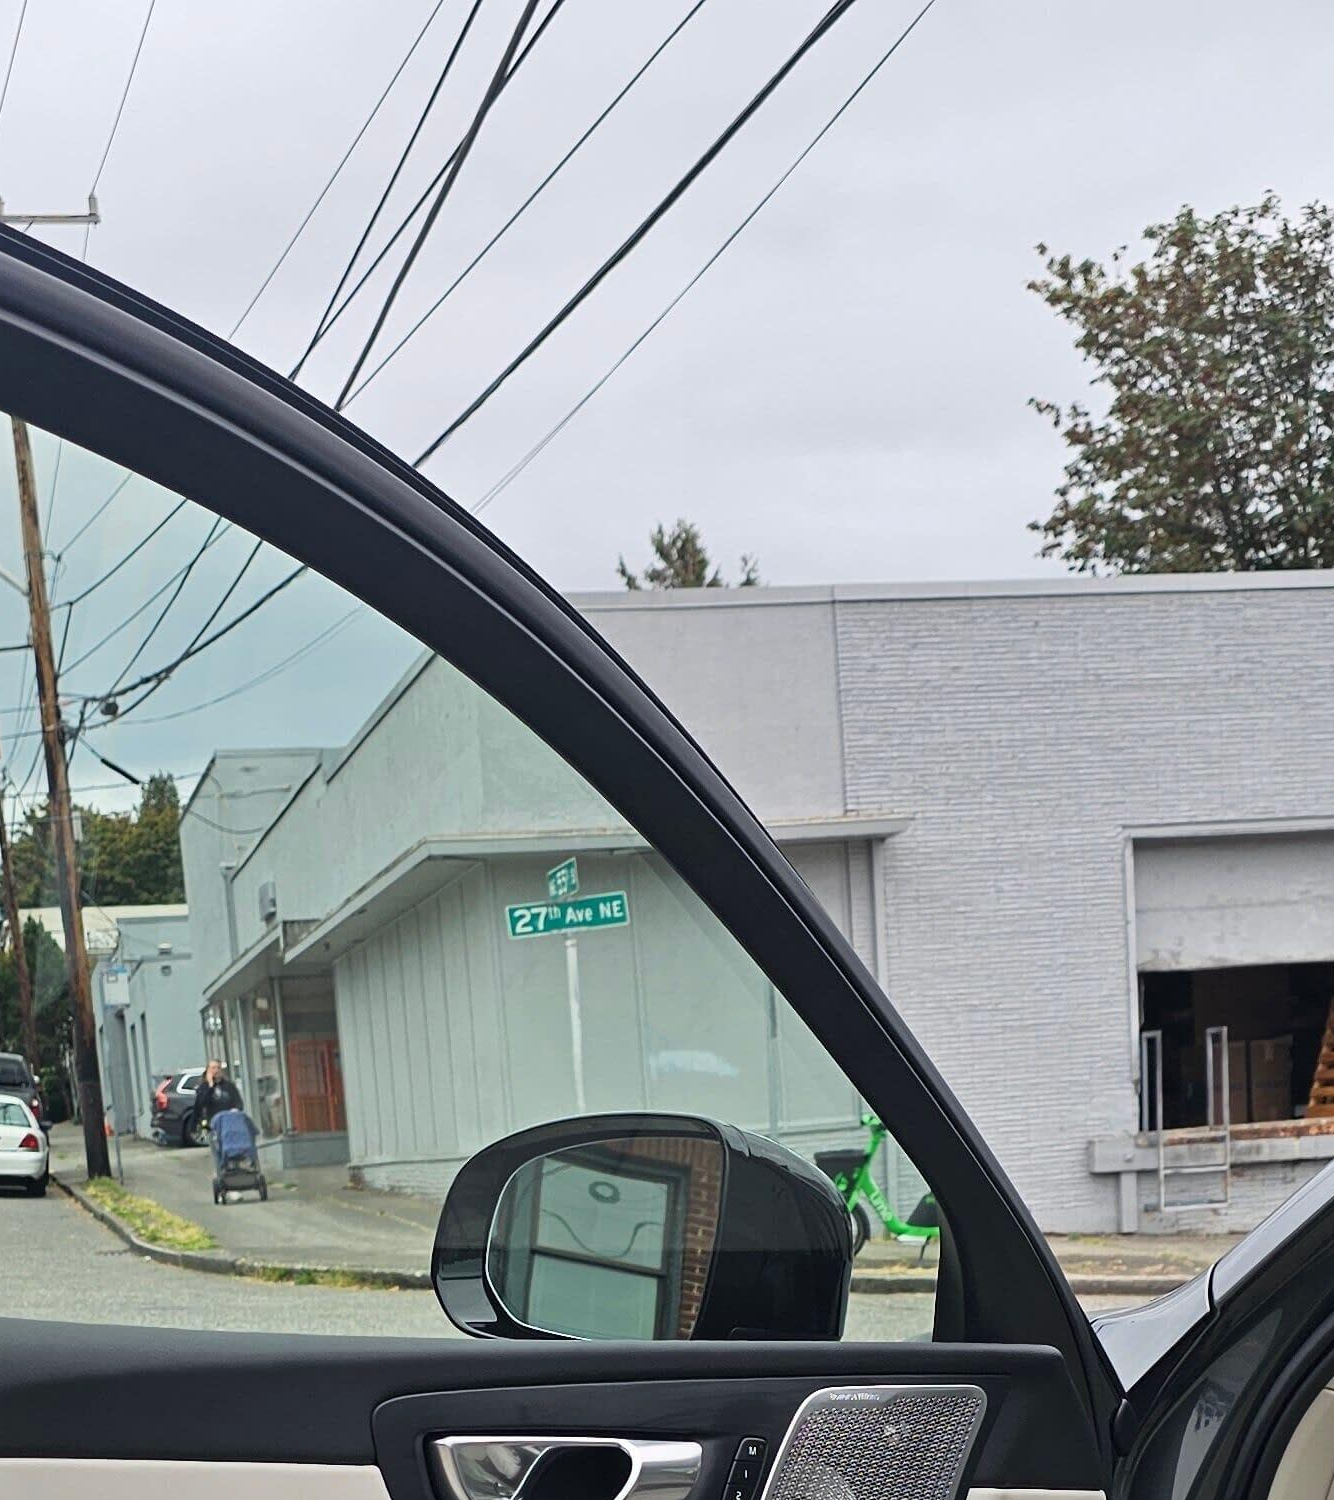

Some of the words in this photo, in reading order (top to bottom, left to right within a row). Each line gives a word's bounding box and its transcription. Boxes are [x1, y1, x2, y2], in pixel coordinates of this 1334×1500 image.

[513, 904, 561, 934] 27th
[565, 907, 593, 924] Ave
[599, 900, 624, 919] NE
